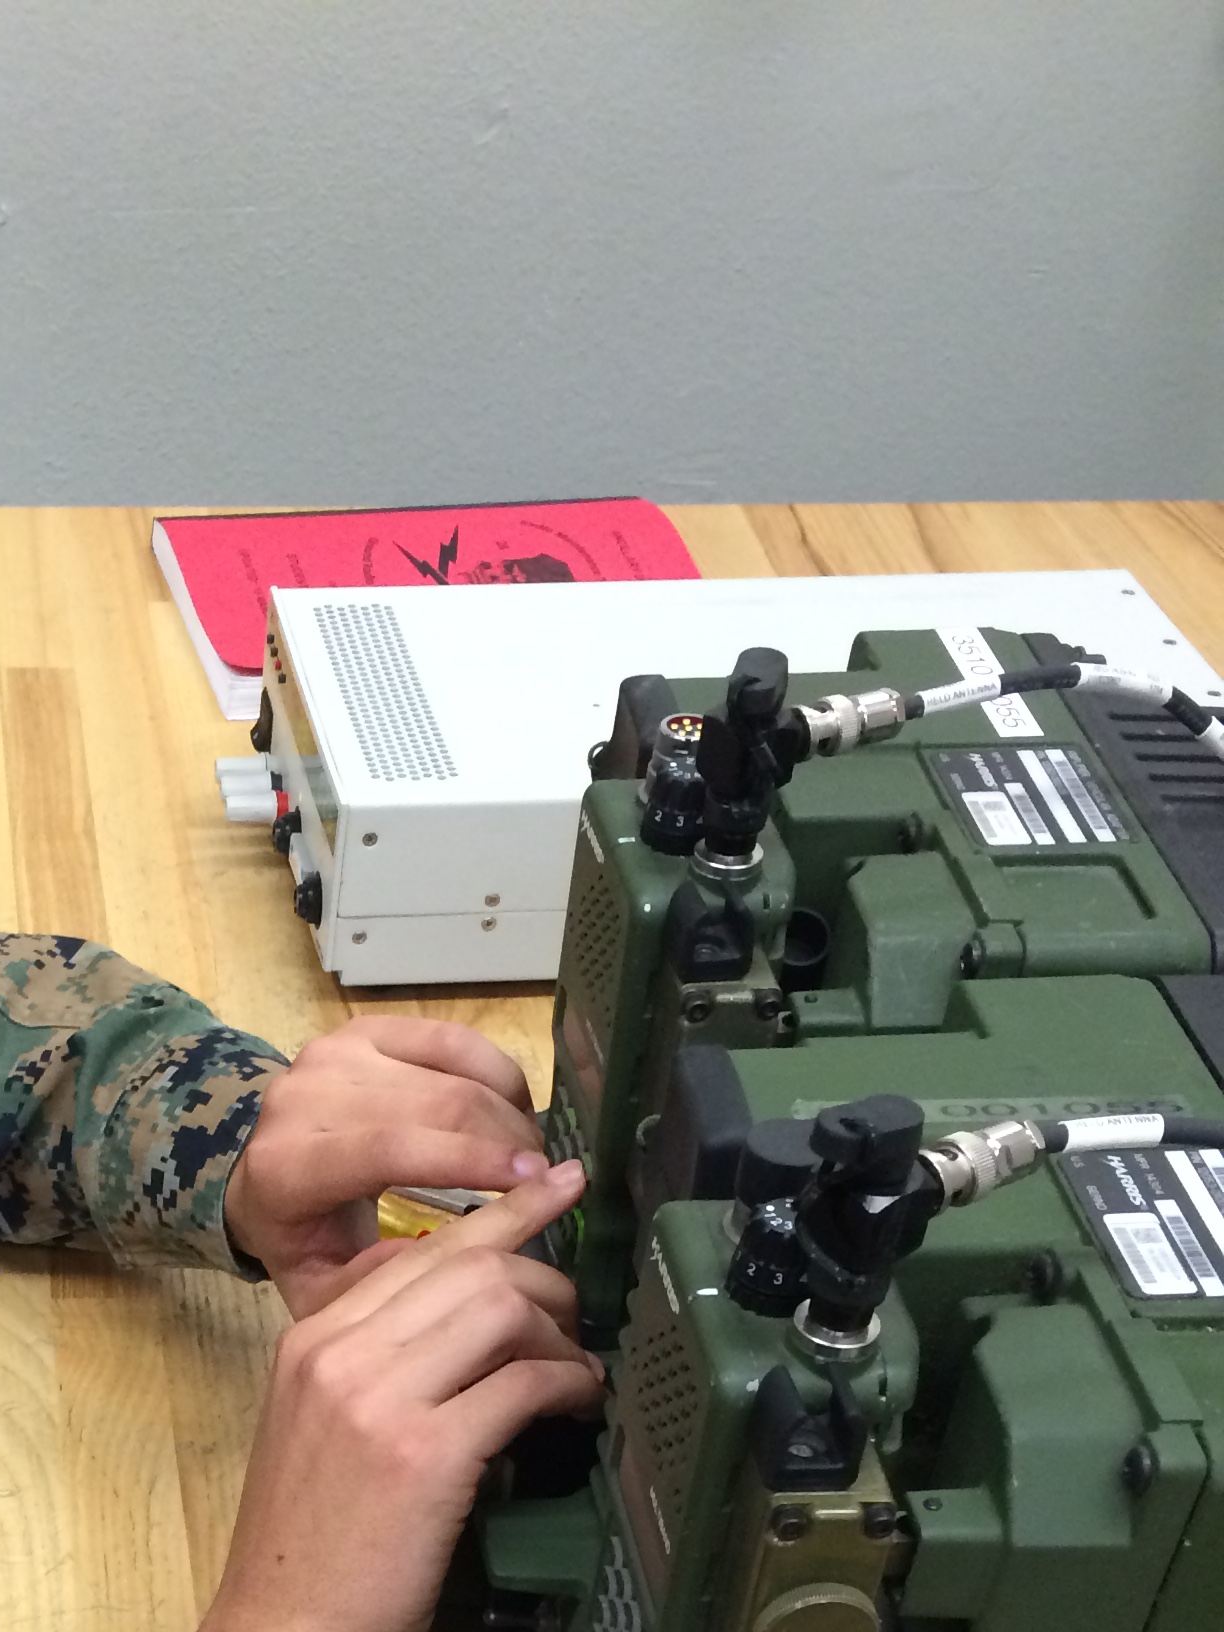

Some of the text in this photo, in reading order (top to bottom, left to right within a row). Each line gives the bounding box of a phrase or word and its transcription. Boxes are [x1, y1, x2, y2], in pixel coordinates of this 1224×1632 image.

[953, 683, 998, 699] ANTENNA
[655, 810, 663, 822] 2
[676, 815, 684, 827] 3
[1107, 1115, 1160, 1125] ANTENNA
[1102, 1155, 1147, 1206] HARRIS
[746, 1262, 756, 1277] 2
[773, 1273, 783, 1285] 3
